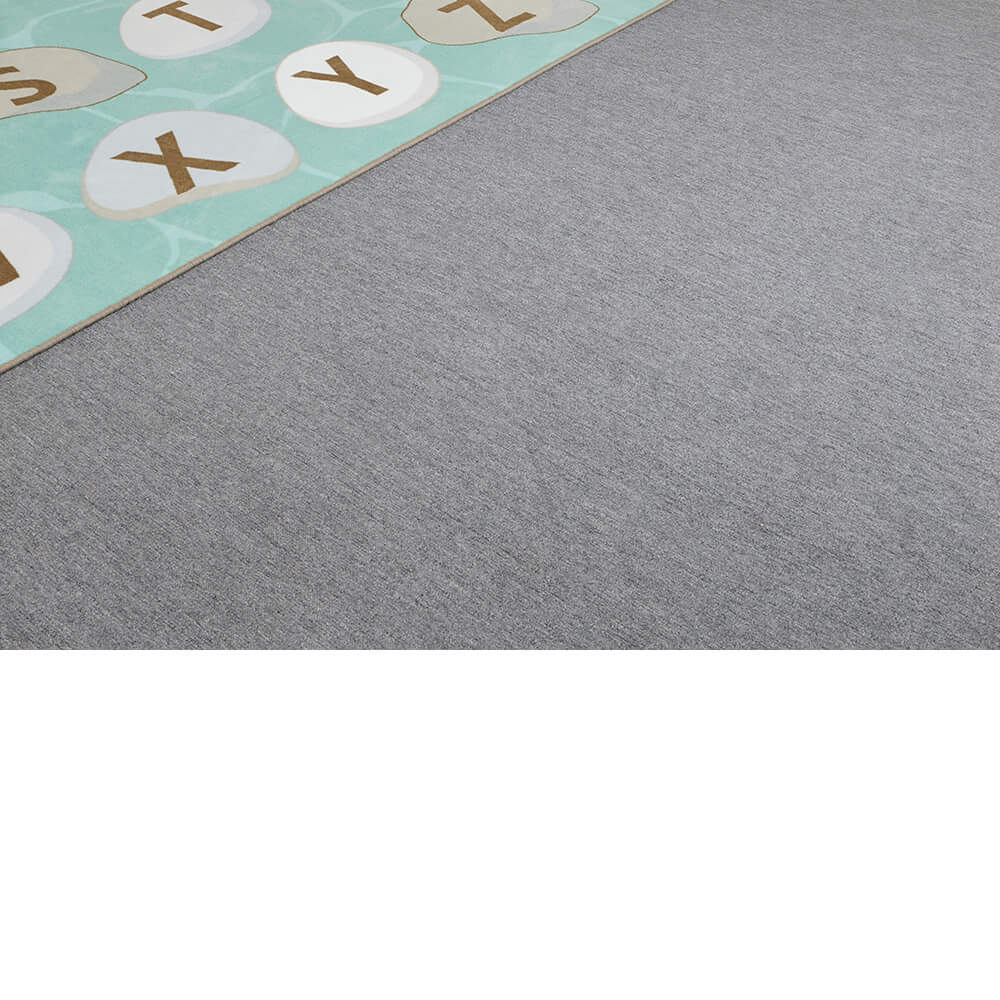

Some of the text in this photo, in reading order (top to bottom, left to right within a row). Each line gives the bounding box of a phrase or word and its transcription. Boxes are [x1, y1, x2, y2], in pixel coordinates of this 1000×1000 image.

[143, 0, 223, 32] T
[292, 55, 389, 96] Y
[111, 131, 240, 196] X
